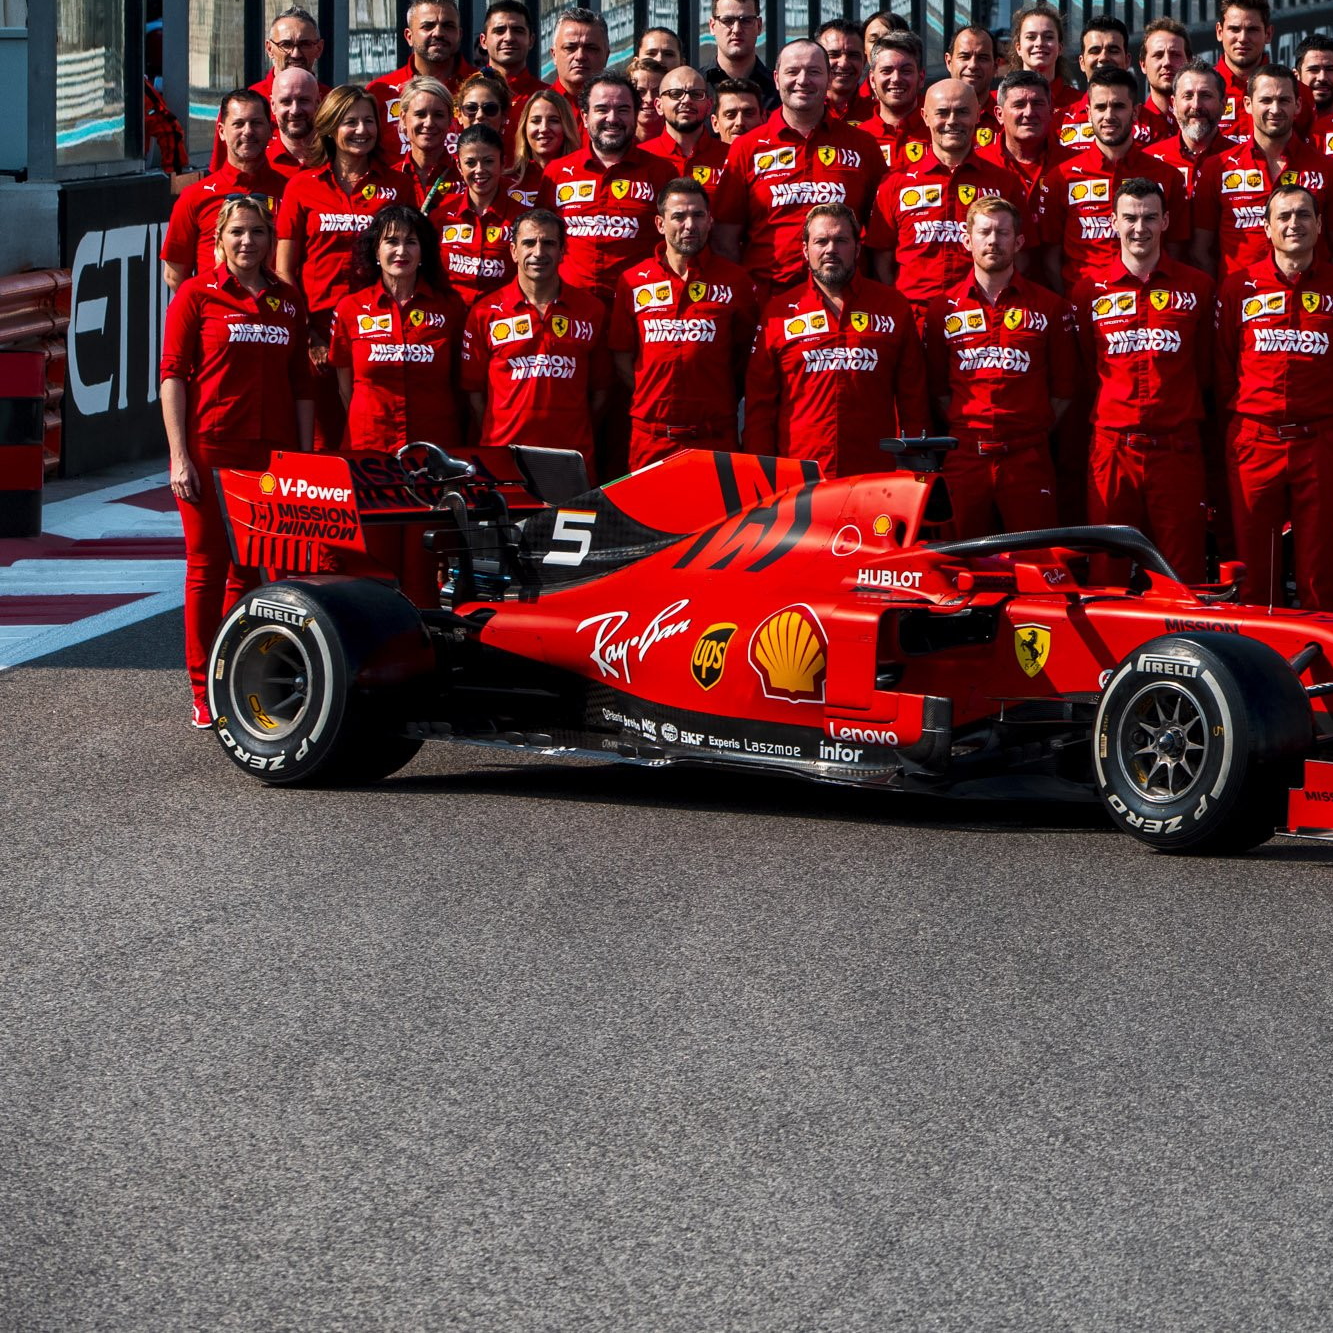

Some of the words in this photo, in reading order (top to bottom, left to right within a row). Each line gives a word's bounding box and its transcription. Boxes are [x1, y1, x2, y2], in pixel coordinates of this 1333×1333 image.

[770, 182, 845, 196] MISSION
[772, 192, 845, 207] WINNOW
[566, 216, 638, 228] MISSION
[566, 226, 638, 238] WINNOW
[449, 253, 505, 268] MISSION
[656, 288, 670, 299] ups
[67, 221, 168, 416] ETI
[644, 319, 716, 332] MISSION
[811, 318, 825, 328] ups
[969, 317, 982, 326] ups
[228, 323, 289, 336] MISSION
[644, 329, 716, 342] WINNOW
[1106, 328, 1180, 343] MISSION
[1254, 328, 1328, 343] MISSION
[229, 333, 290, 346] WINNOW
[1109, 340, 1180, 354] WINNOW
[1254, 340, 1328, 354] WINNOW
[370, 344, 434, 354] MISSION
[802, 347, 878, 361] MISSION
[958, 347, 1030, 361] MISSION
[509, 354, 576, 369] MISSION
[805, 358, 878, 372] WINNOW
[959, 358, 1030, 372] WINNOW
[511, 365, 576, 380] WINNOW
[279, 478, 351, 502] V-Power
[278, 502, 357, 525] MISSION
[276, 520, 357, 541] WINNOW
[543, 509, 597, 566] 5
[856, 568, 923, 588] HUBLOT
[248, 598, 308, 627] PIRELLI
[694, 637, 726, 679] ups
[1137, 653, 1200, 678] PIRELLI
[681, 730, 705, 746] SKF
[709, 735, 740, 749] Experis
[828, 721, 898, 747] Lenovo
[219, 728, 286, 771] ZERO
[819, 740, 863, 763] infor
[1107, 793, 1185, 835] ZERO
